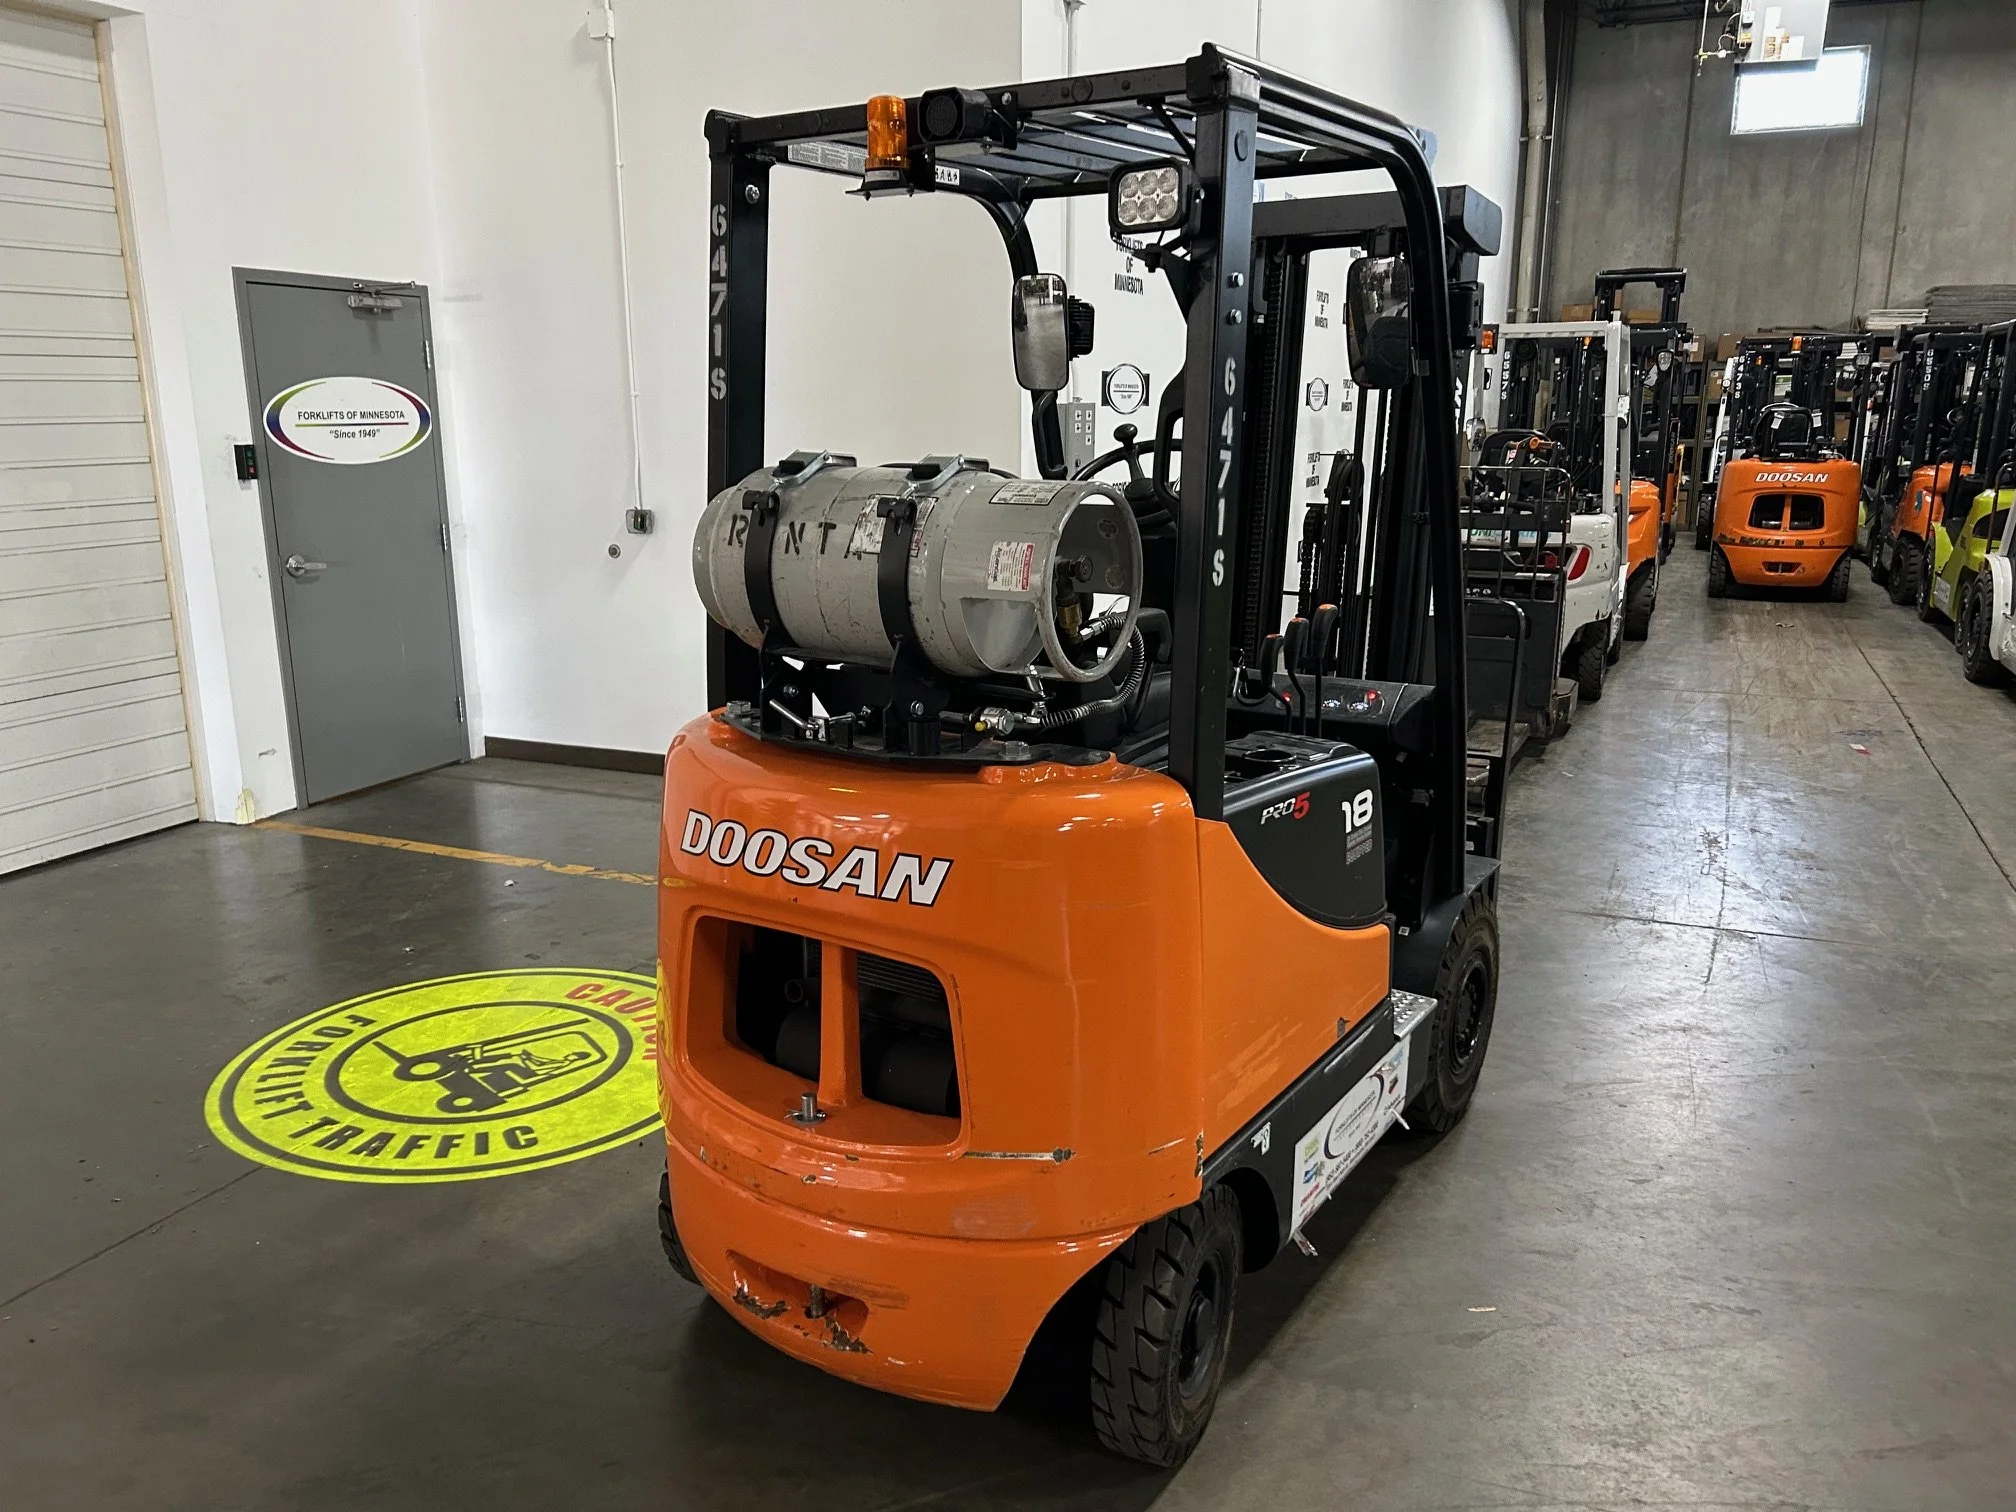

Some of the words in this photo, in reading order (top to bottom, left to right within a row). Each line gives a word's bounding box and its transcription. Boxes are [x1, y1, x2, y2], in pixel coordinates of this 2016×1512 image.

[710, 204, 728, 401] 6471S
[297, 411, 345, 421] FORKLIFTS
[348, 411, 358, 420] OF
[359, 410, 405, 420] MINNESOTA
[1212, 356, 1237, 587] 6471S
[1755, 472, 1829, 484] DOOSAN
[1341, 788, 1373, 834] 18
[680, 807, 954, 909] DOOSAN
[254, 1013, 377, 1120] FORKLIFT
[288, 1115, 539, 1160] TRAFFIC
